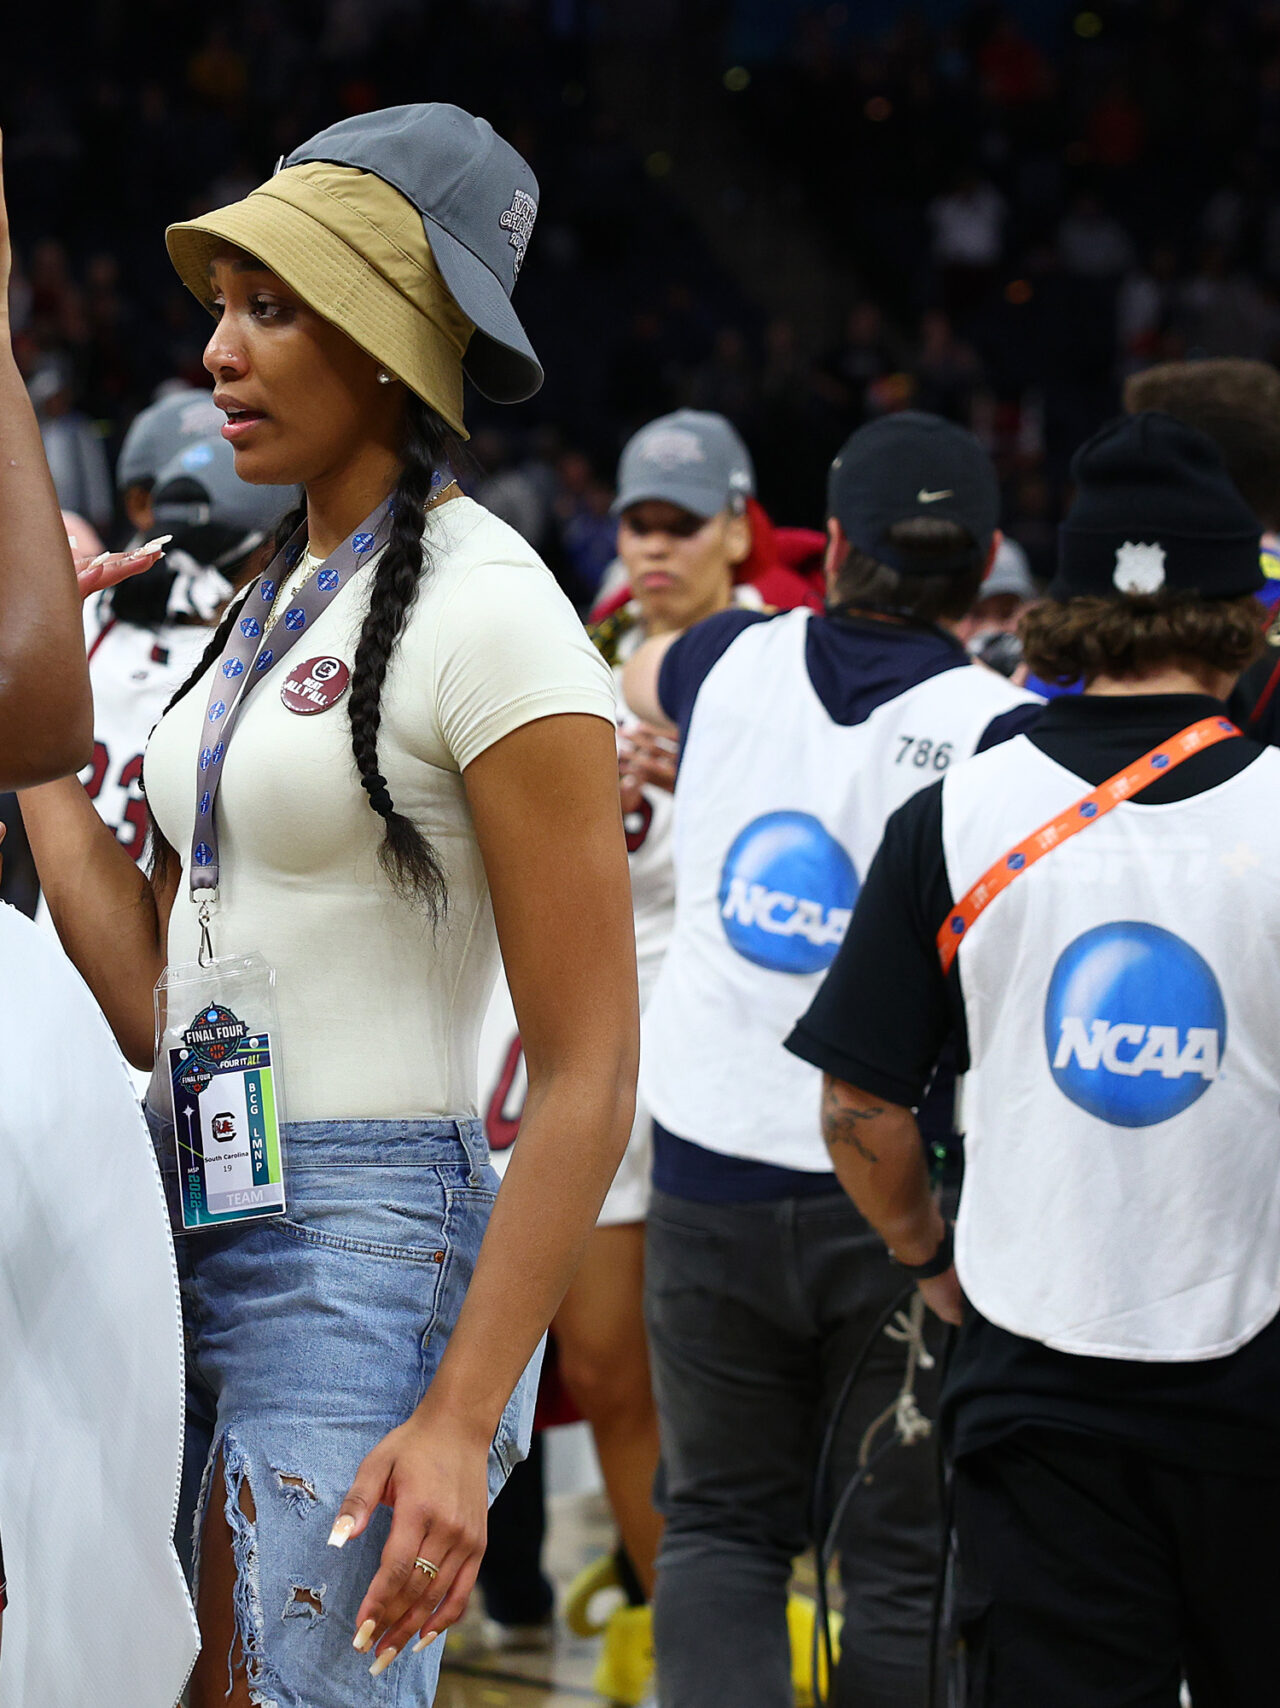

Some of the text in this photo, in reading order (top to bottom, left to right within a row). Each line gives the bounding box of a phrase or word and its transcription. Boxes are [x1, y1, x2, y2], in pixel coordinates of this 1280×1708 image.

[284, 680, 302, 694] ALL
[302, 677, 325, 691] BEAT
[895, 735, 954, 771] 786
[722, 877, 854, 945] NCAA
[186, 1029, 214, 1044] FINAL
[216, 1025, 244, 1039] FOUR
[1053, 1016, 1220, 1081] NCAA
[220, 1058, 240, 1069] FOUR
[247, 1055, 261, 1066] ALL
[182, 1073, 211, 1083] FINAL FOUR
[205, 1151, 249, 1163] South Carolina
[188, 1174, 202, 1208] 2022
[227, 1190, 264, 1206] TEAM
